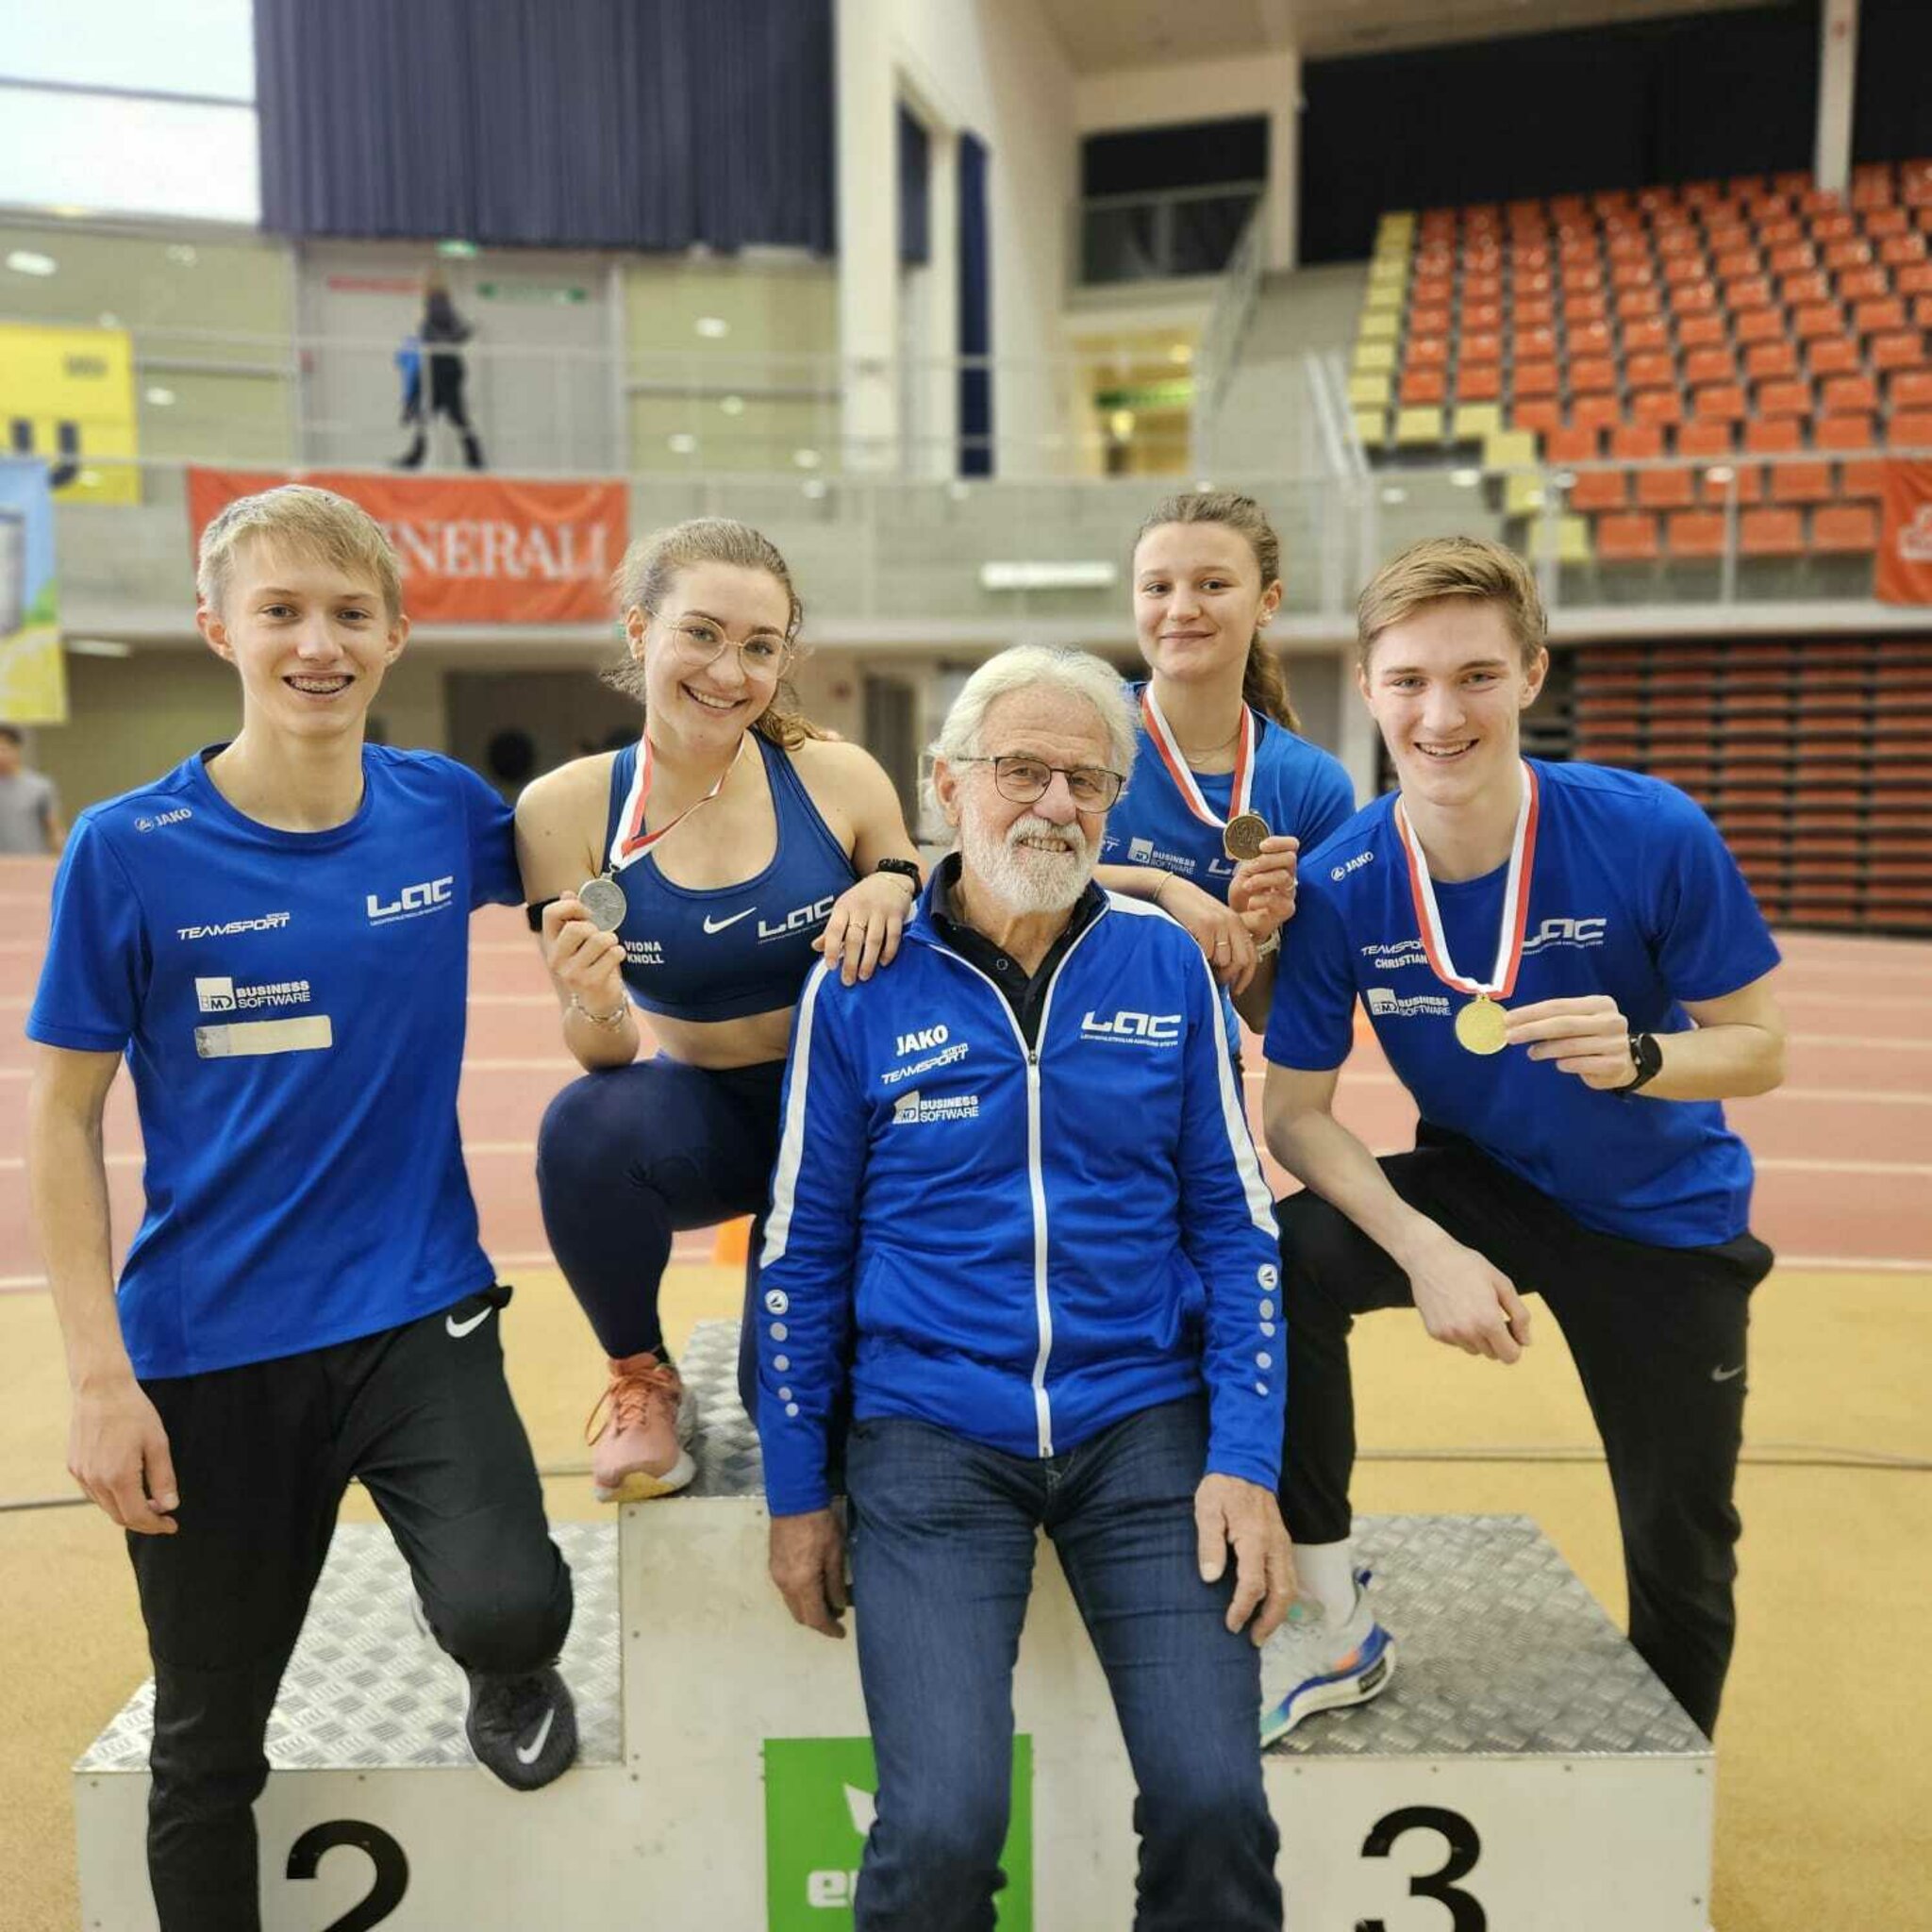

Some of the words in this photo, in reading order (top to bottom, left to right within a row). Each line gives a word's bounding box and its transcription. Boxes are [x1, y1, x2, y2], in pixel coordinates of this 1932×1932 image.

[384, 519, 609, 580] NERALI
[156, 808, 192, 826] JAKO
[1151, 858, 1195, 874] SOFTWARE
[1152, 850, 1196, 868] BUSINESS
[1345, 851, 1374, 873] JAKO
[176, 915, 291, 941] TEAMSPORT
[624, 940, 662, 953] VIONA
[626, 953, 665, 964] KNOLL
[1374, 953, 1428, 969] CHRISTIAN
[235, 980, 310, 998] BUSINESS
[237, 991, 311, 1009] SOFTWARE
[1396, 996, 1450, 1008] BUSINESS
[1397, 1005, 1453, 1017] SOFTWARE
[896, 1024, 948, 1057] JAKO
[881, 1047, 968, 1085] TEAMSPORT
[920, 1095, 978, 1110] BUSINESS
[920, 1106, 980, 1124] SOFTWARE
[286, 1819, 409, 1932] 2
[1354, 1806, 1488, 1932] 3
